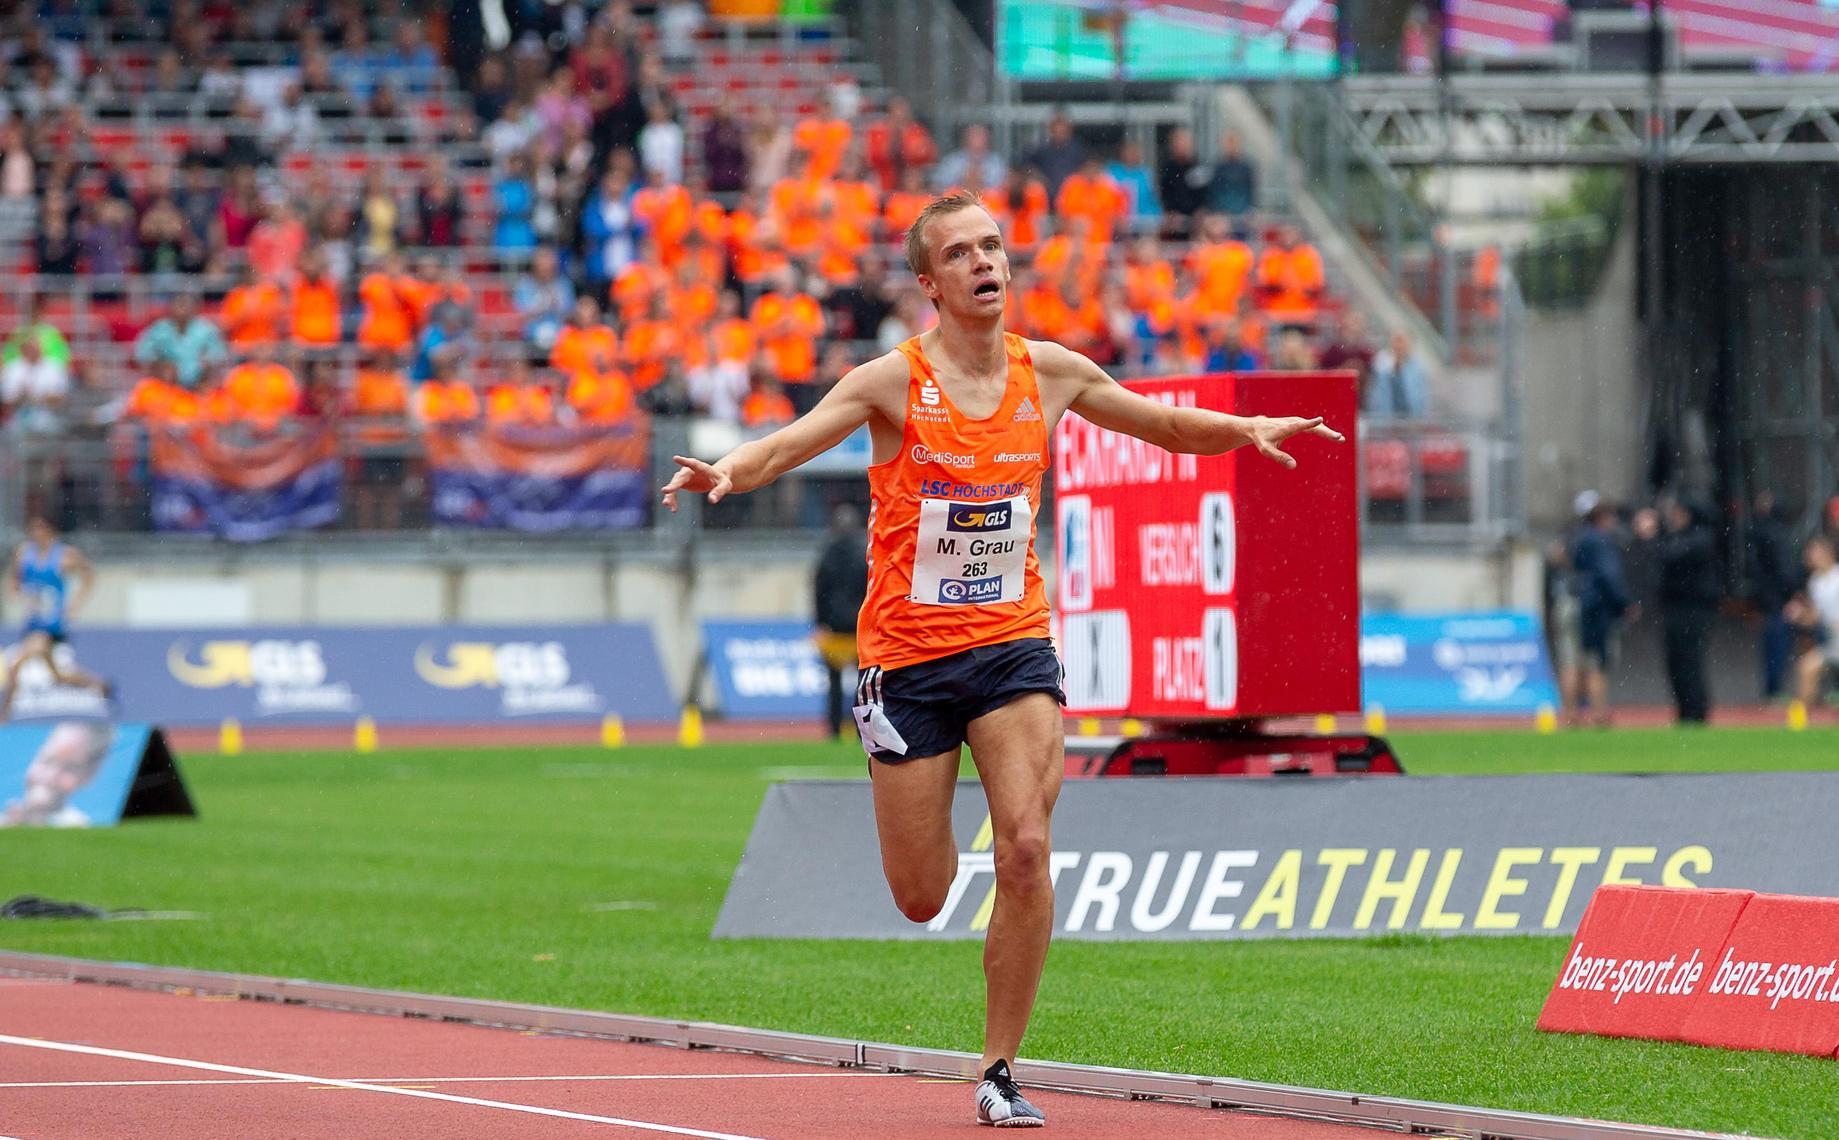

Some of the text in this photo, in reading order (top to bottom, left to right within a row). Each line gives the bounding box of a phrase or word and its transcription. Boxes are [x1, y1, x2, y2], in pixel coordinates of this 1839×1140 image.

[915, 447, 975, 467] MediSport
[921, 479, 1024, 498] LSC HÖCHSTADT
[984, 509, 1008, 527] GLS
[936, 538, 1015, 556] M. Grau
[962, 562, 988, 577] 263
[968, 580, 1000, 596] PLAN
[1559, 942, 1704, 1004] benz-sport.de
